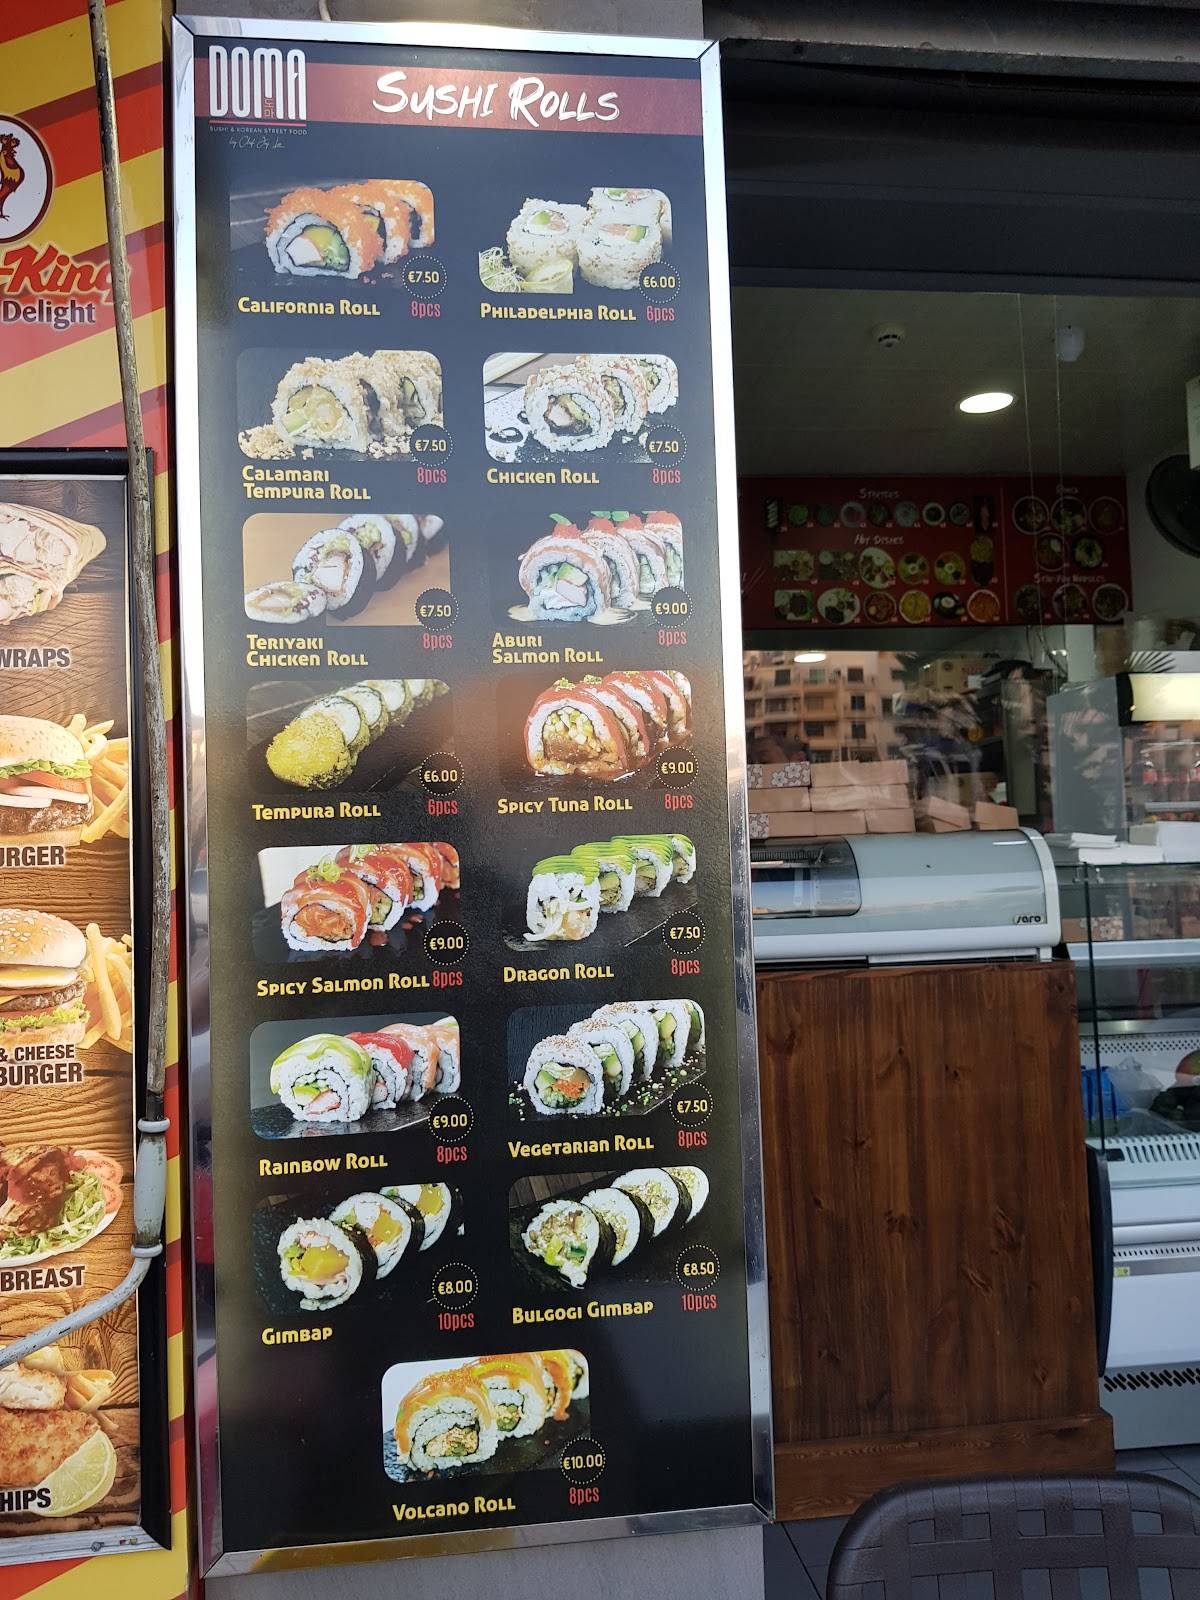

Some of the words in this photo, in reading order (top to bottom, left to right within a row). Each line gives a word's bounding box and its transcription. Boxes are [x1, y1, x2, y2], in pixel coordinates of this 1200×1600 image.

[208, 45, 306, 120] DOMA
[408, 271, 439, 284] €7.50
[643, 275, 675, 289] €6.00
[2, 299, 96, 330] Delight
[411, 300, 441, 319] 8pcs
[646, 305, 675, 323] 6pcs
[415, 439, 447, 452] €7.50
[649, 440, 679, 453] €7.50
[416, 467, 448, 485] 8pcs
[652, 468, 681, 486] 8pcs
[420, 604, 452, 617] €7.50
[655, 602, 688, 615] €9.00
[422, 632, 453, 650] 8pcs
[658, 629, 687, 647] 8pcs
[424, 769, 458, 783] €6.00
[661, 761, 694, 774] €9.00
[427, 799, 458, 816] 6pcs
[664, 793, 694, 810] 8pcs
[669, 926, 700, 940] €7.50
[429, 936, 464, 950] €9.00
[671, 958, 700, 976] 8pcs
[432, 970, 463, 990] 8pcs
[15, 1044, 75, 1061] CHEESE
[677, 1100, 708, 1113] €7.50
[432, 1114, 468, 1129] €9.00
[678, 1130, 708, 1148] 8pcs
[436, 1146, 468, 1164] 8pcs
[683, 1262, 714, 1276] €8.50
[1, 1265, 86, 1291] BREAST
[437, 1280, 473, 1295] €8.00
[682, 1294, 717, 1312] 10pcs
[438, 1312, 475, 1332] 10pcs
[563, 1454, 603, 1470] €10.00
[569, 1487, 600, 1506] 8pcs
